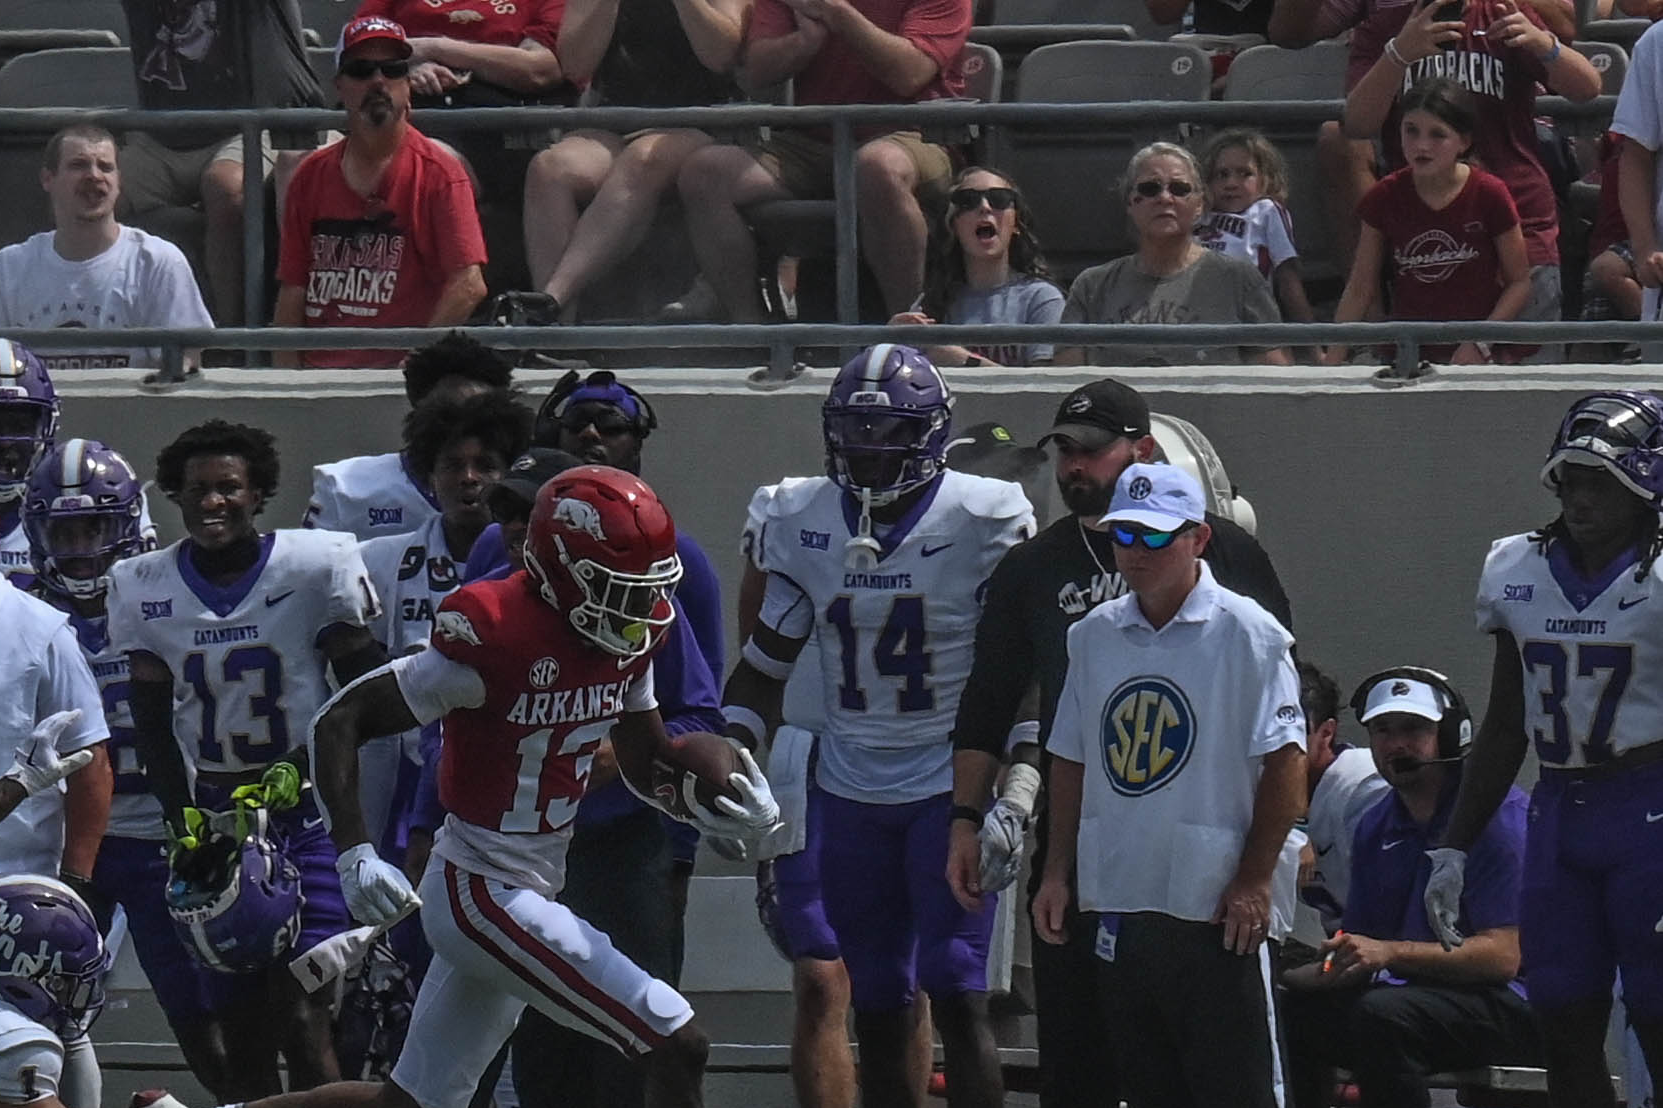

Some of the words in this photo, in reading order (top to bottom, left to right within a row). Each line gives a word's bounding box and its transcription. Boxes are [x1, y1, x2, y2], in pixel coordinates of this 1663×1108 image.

[368, 507, 403, 527] SOCON
[844, 573, 912, 590] CATAMOUNTS
[194, 625, 259, 646] CATAMOUNTS
[531, 659, 557, 687] SEC
[826, 595, 935, 713] 14
[184, 645, 289, 765] 13
[1108, 689, 1181, 784] SEC
[1523, 641, 1634, 765] 37
[500, 718, 620, 834] 13
